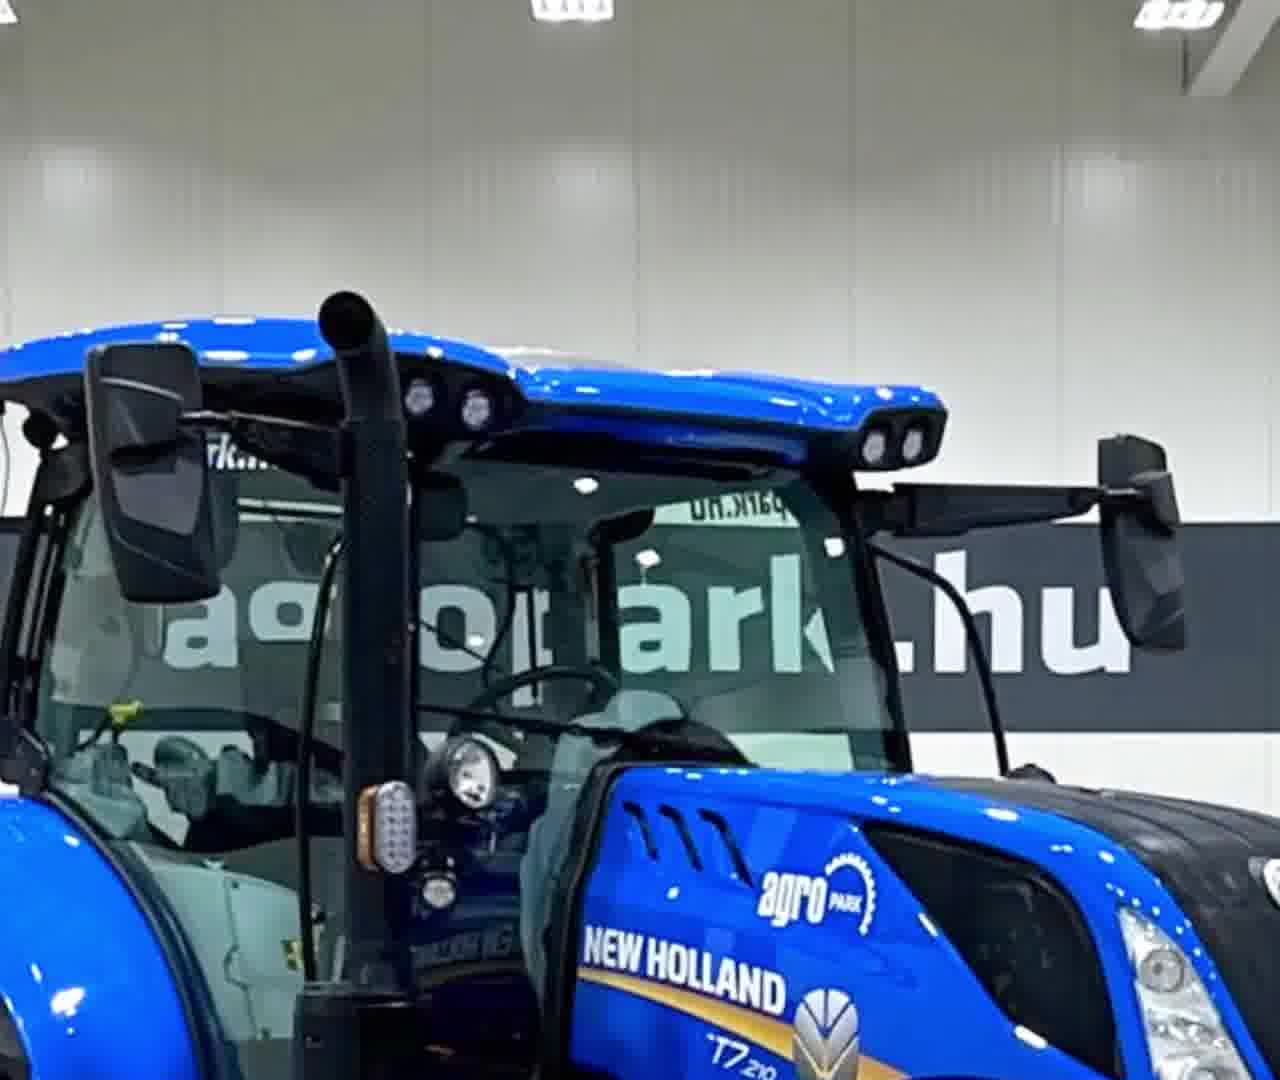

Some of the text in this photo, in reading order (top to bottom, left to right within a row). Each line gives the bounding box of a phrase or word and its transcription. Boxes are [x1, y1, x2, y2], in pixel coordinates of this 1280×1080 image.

[757, 871, 863, 928] agro PARK
[584, 925, 644, 972] NEW
[646, 938, 787, 1017] HOLLAND
